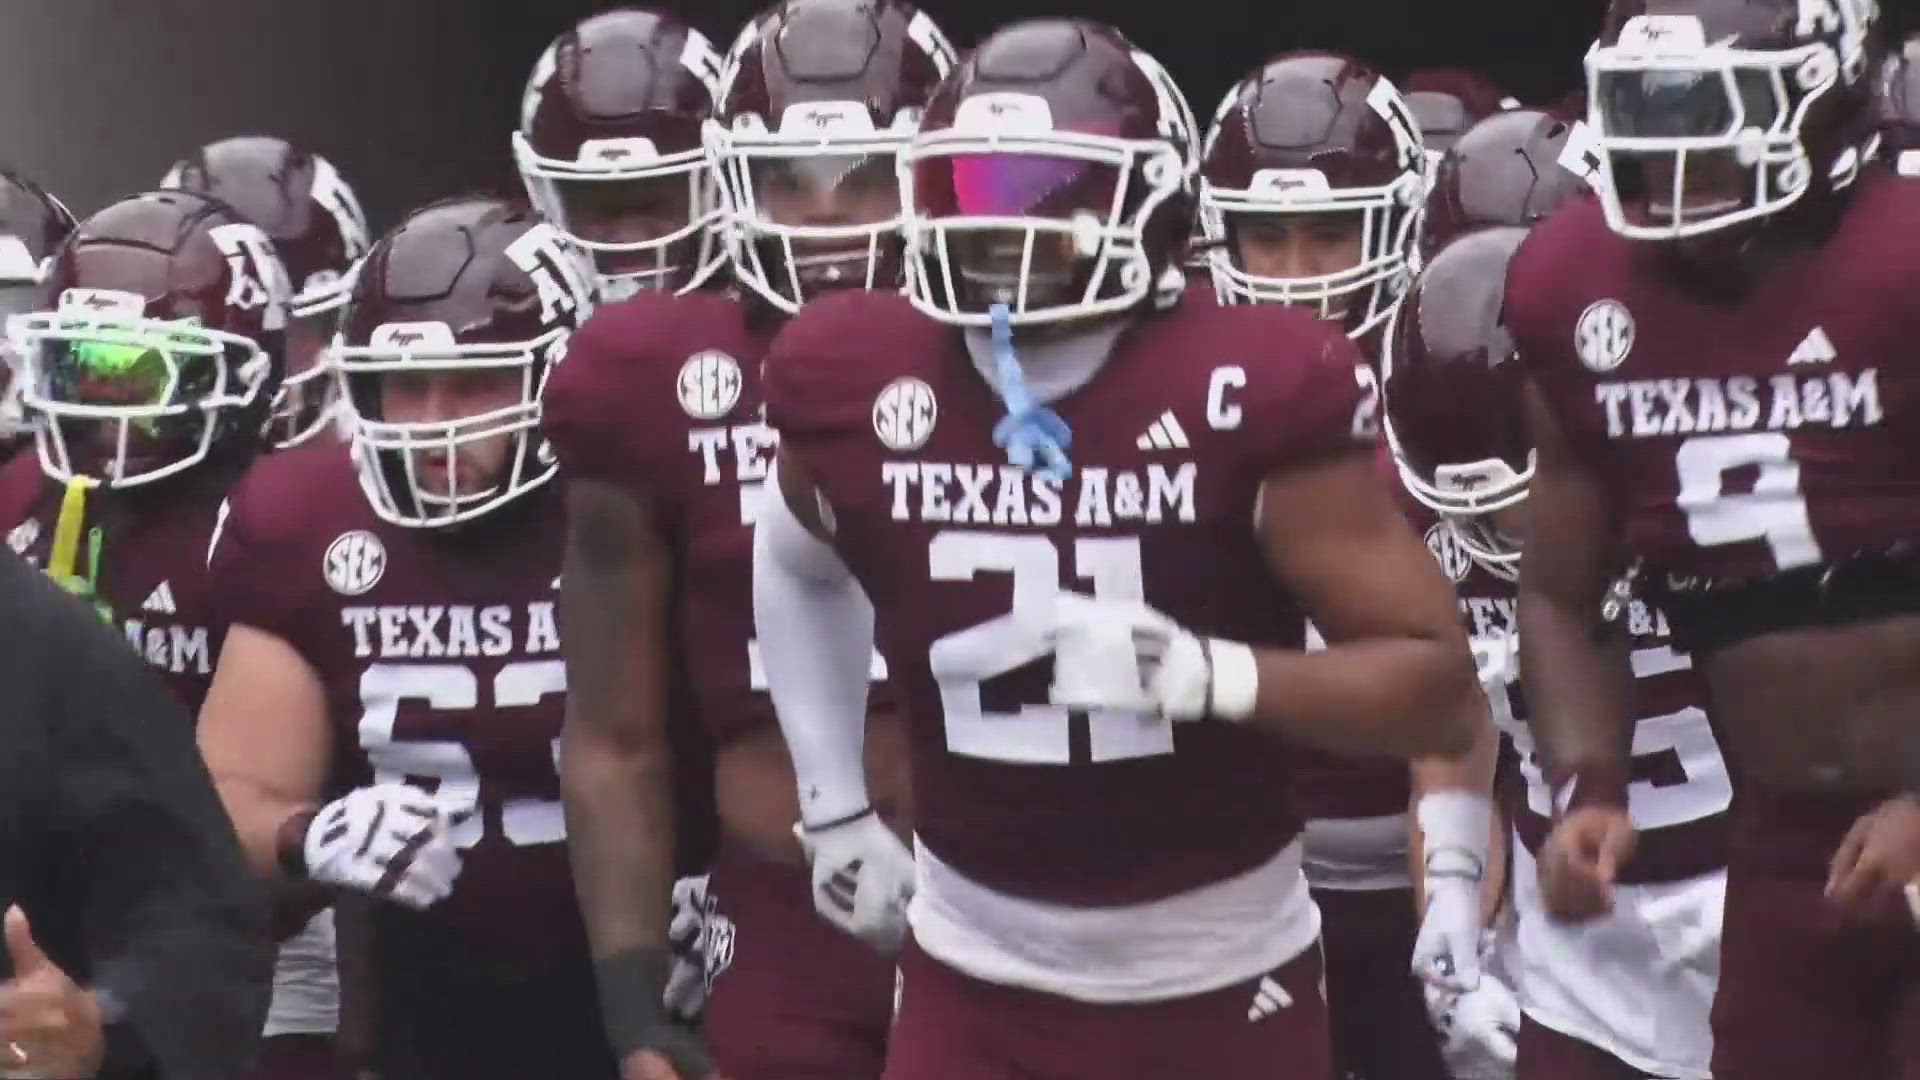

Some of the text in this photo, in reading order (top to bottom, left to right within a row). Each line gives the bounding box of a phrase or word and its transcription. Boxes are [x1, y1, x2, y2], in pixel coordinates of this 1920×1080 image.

[874, 377, 936, 449] SEC
[1206, 365, 1246, 429] C
[1595, 368, 1883, 438] TEXAS A&M
[688, 425, 767, 484] TE
[882, 460, 1197, 526] TEXAS A&M
[1675, 432, 1822, 570] 9
[325, 531, 385, 595] SEC
[341, 602, 560, 657] TEXAS A
[929, 531, 1174, 765] 21
